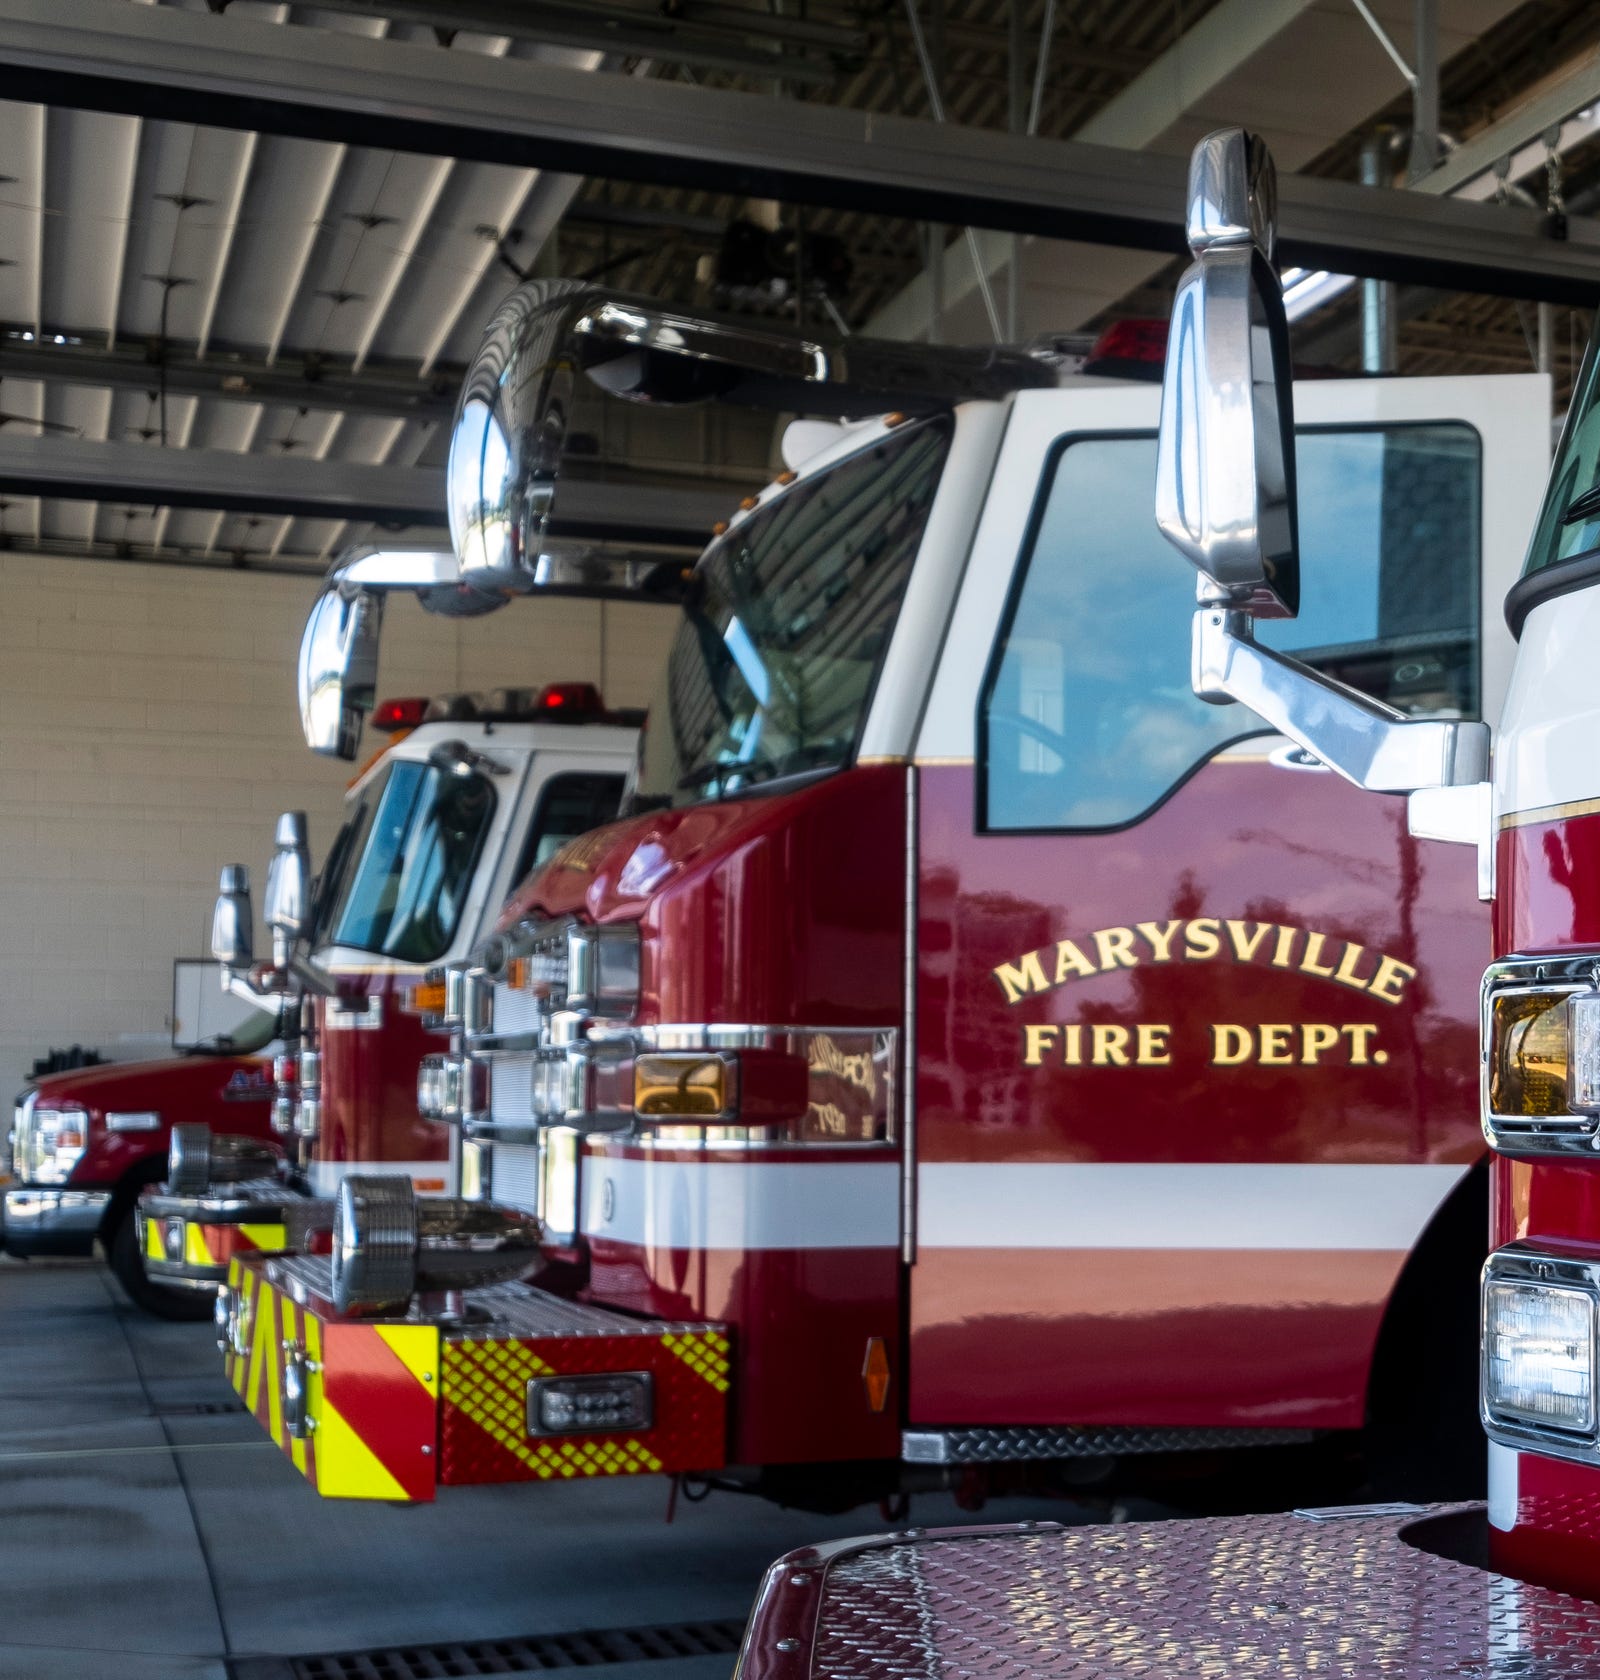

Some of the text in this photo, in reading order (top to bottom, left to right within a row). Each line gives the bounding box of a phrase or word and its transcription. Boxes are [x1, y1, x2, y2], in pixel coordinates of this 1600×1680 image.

[993, 918, 1416, 1003] MARYSVILLE
[1023, 1024, 1389, 1065] FIRE DEPT.
